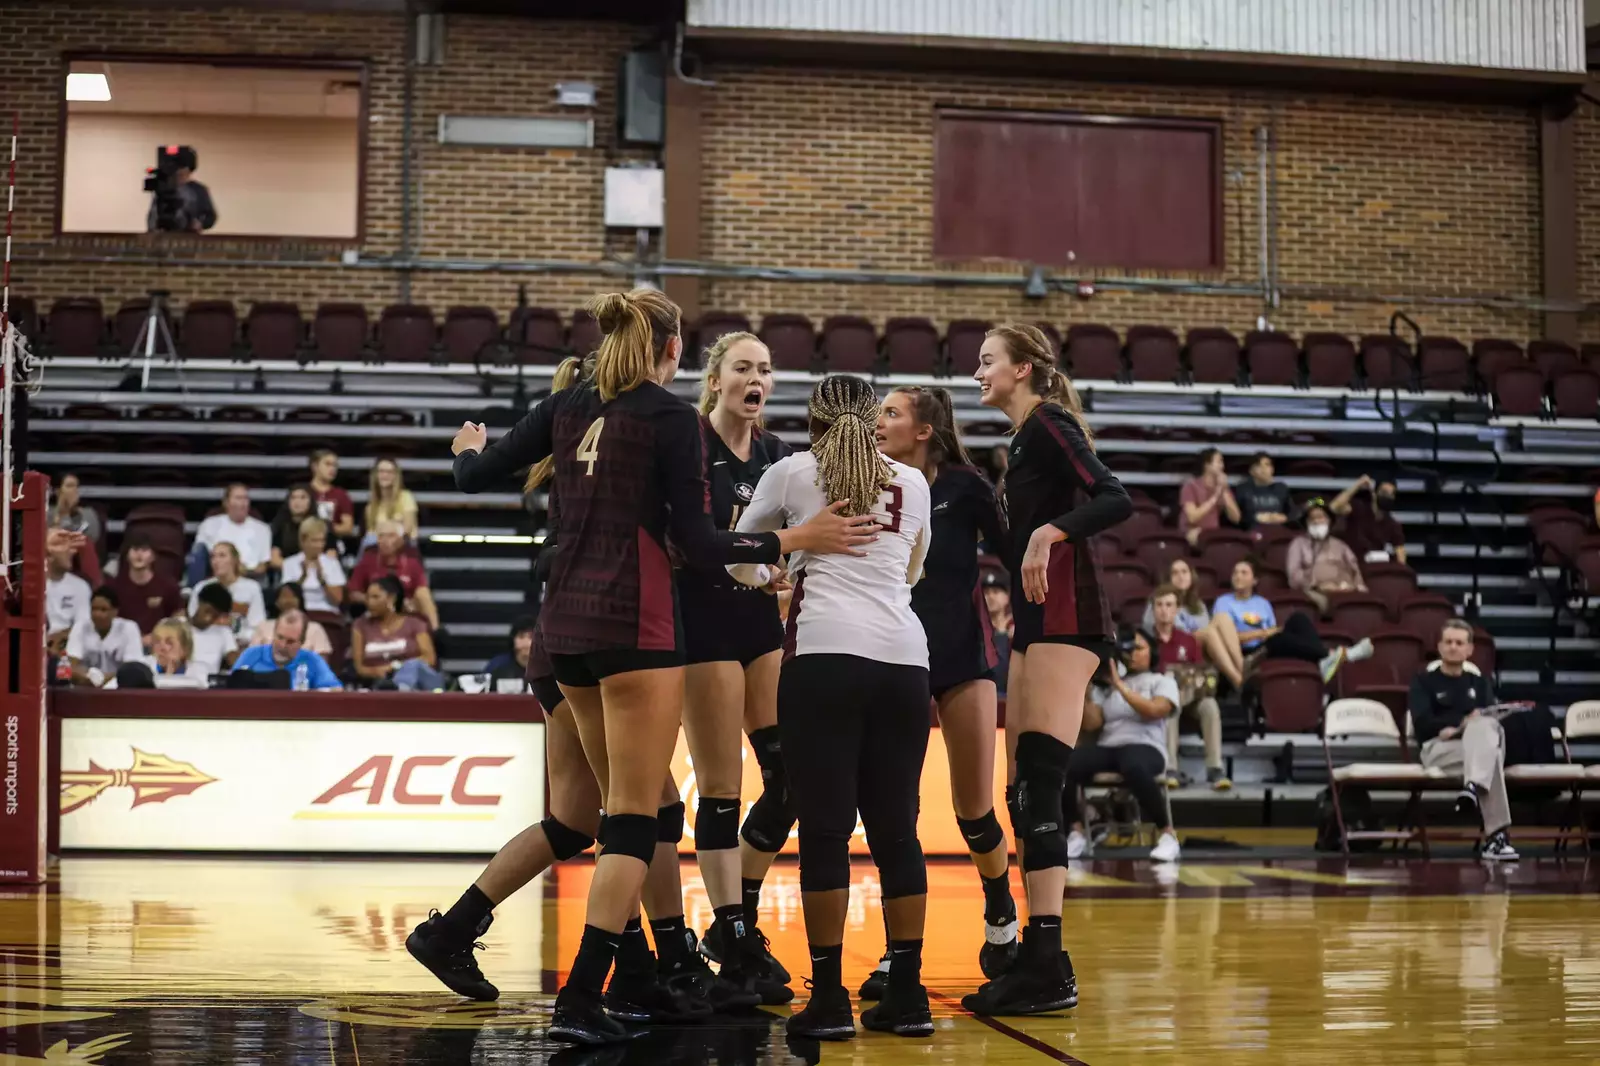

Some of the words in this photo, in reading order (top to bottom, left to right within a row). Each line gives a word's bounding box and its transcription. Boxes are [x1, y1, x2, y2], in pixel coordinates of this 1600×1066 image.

[577, 416, 605, 476] 4
[5, 715, 19, 760] sports
[4, 761, 18, 815] imports
[310, 755, 516, 806] ACC
